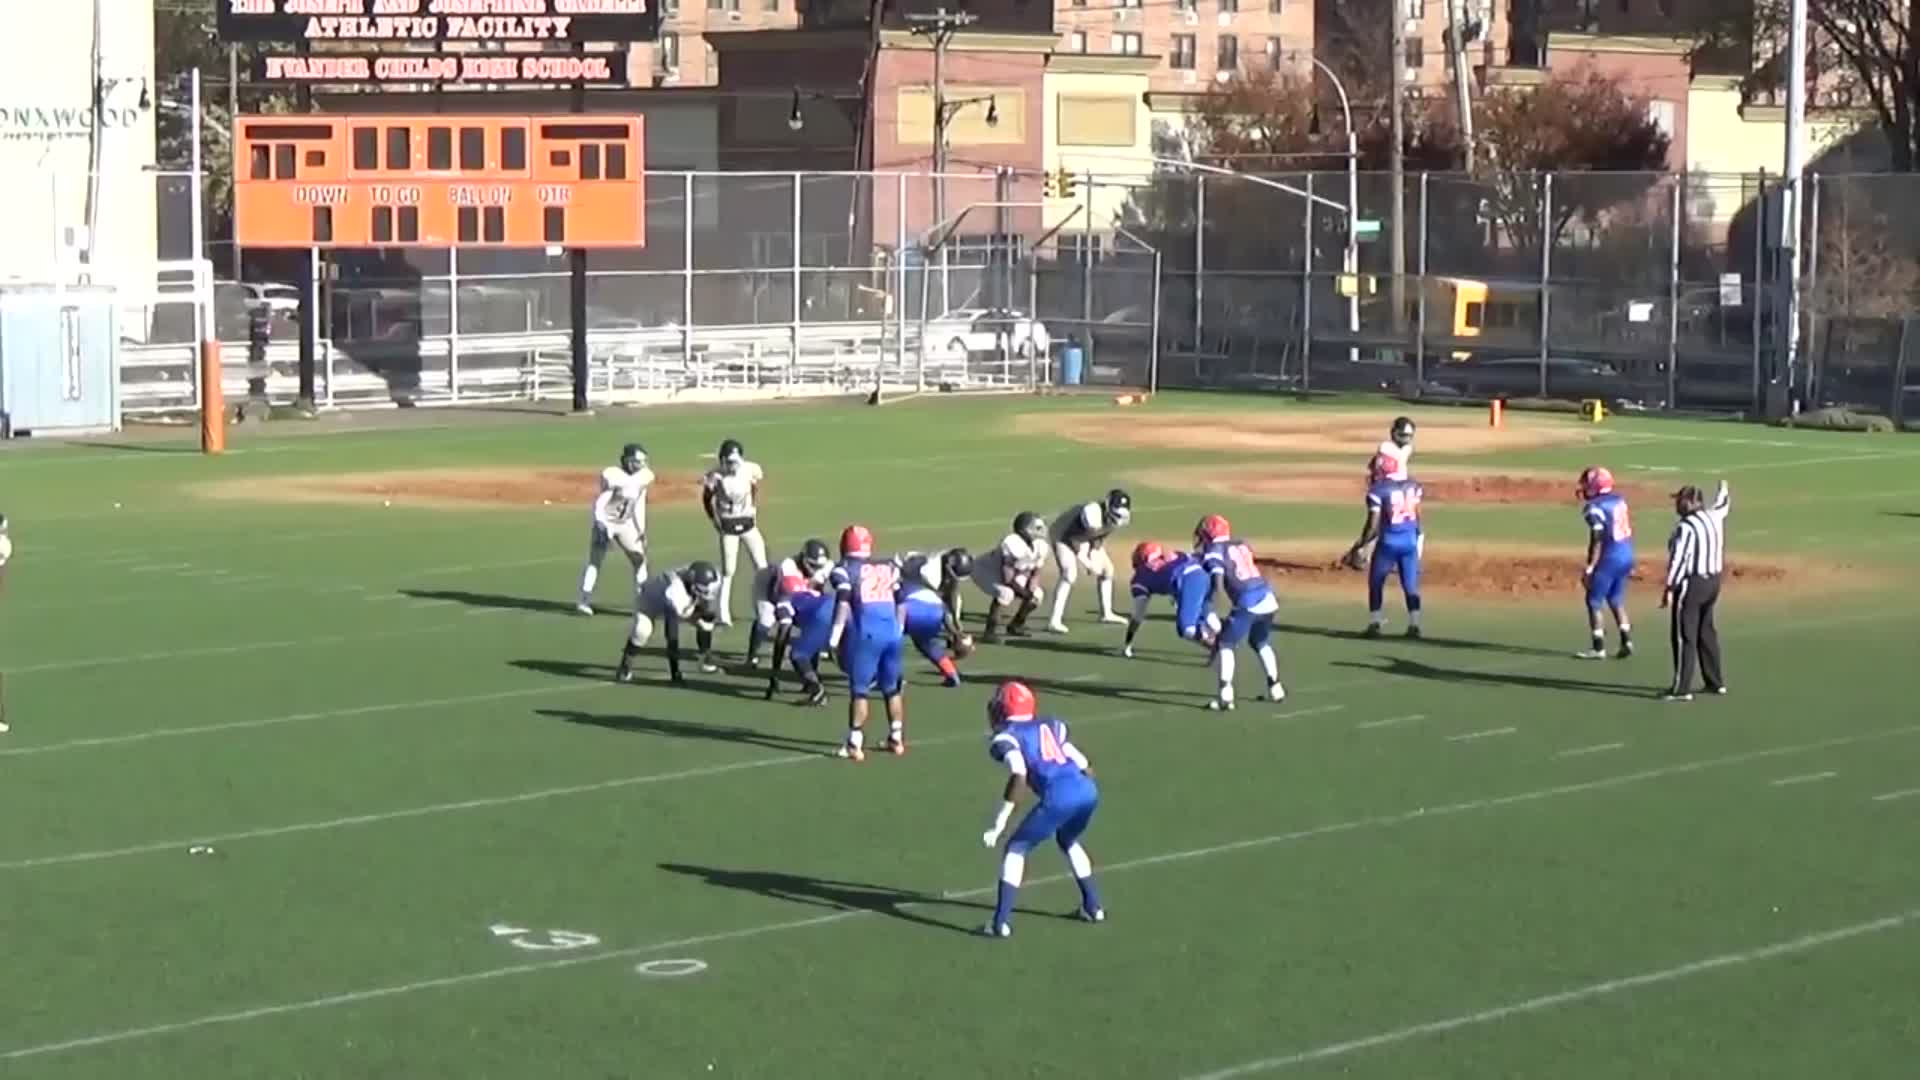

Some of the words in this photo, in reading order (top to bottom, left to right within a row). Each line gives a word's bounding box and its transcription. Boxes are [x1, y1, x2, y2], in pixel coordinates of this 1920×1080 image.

[304, 16, 439, 38] ATHLETIC
[446, 16, 571, 38] FACILITY
[266, 57, 370, 79] EVANDER
[375, 57, 458, 79] CHILDS
[462, 57, 519, 79] HIGH
[522, 57, 611, 79] SCHOOL
[296, 187, 349, 203] DOWN
[370, 187, 392, 203] TO
[397, 187, 421, 203] GO
[449, 186, 484, 203] BALL
[1040, 723, 1067, 765] 4
